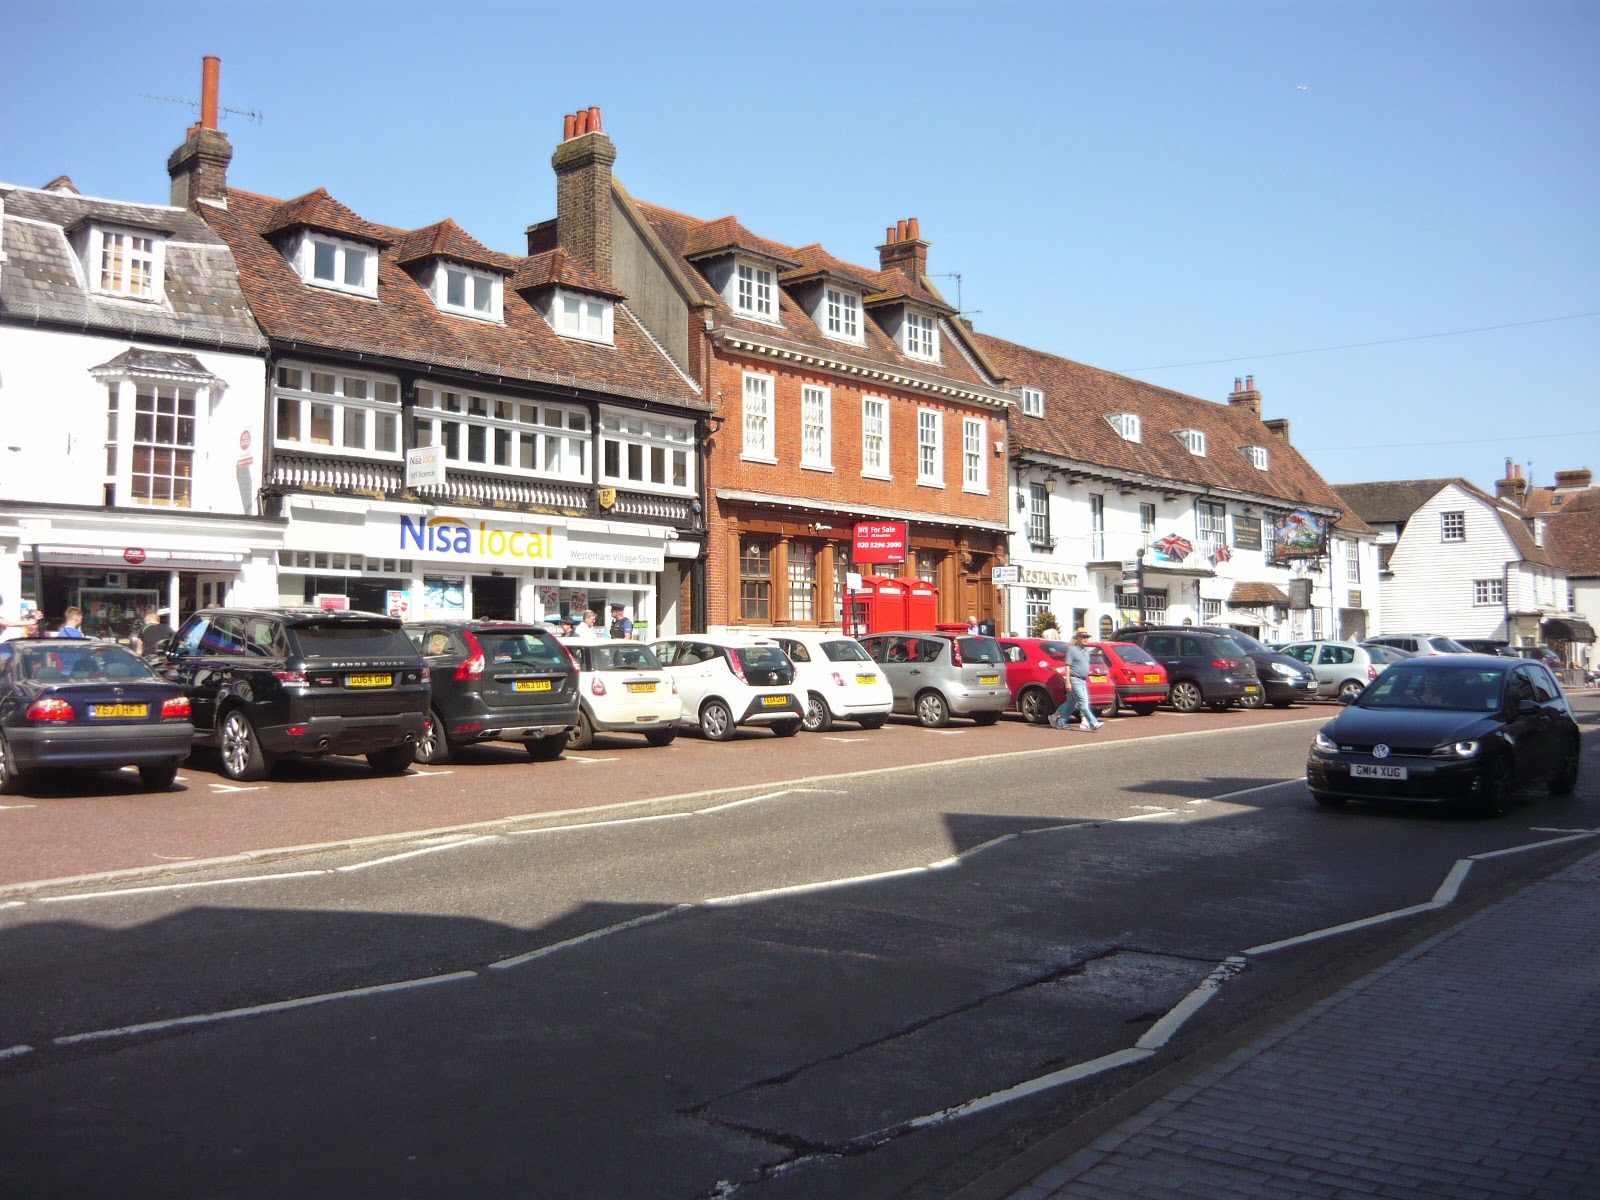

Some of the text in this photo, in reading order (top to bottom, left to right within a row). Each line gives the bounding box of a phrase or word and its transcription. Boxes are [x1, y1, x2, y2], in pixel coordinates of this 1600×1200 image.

[410, 456, 422, 465] Nisa
[418, 470, 436, 478] licence
[399, 514, 552, 559] Nisa local
[570, 549, 660, 565] Westerham Village Stores
[1020, 566, 1078, 587] RESTAURANT
[351, 674, 391, 684] GU64 GRF
[122, 704, 143, 715] HFT
[1356, 765, 1400, 777] GM14 XUG
